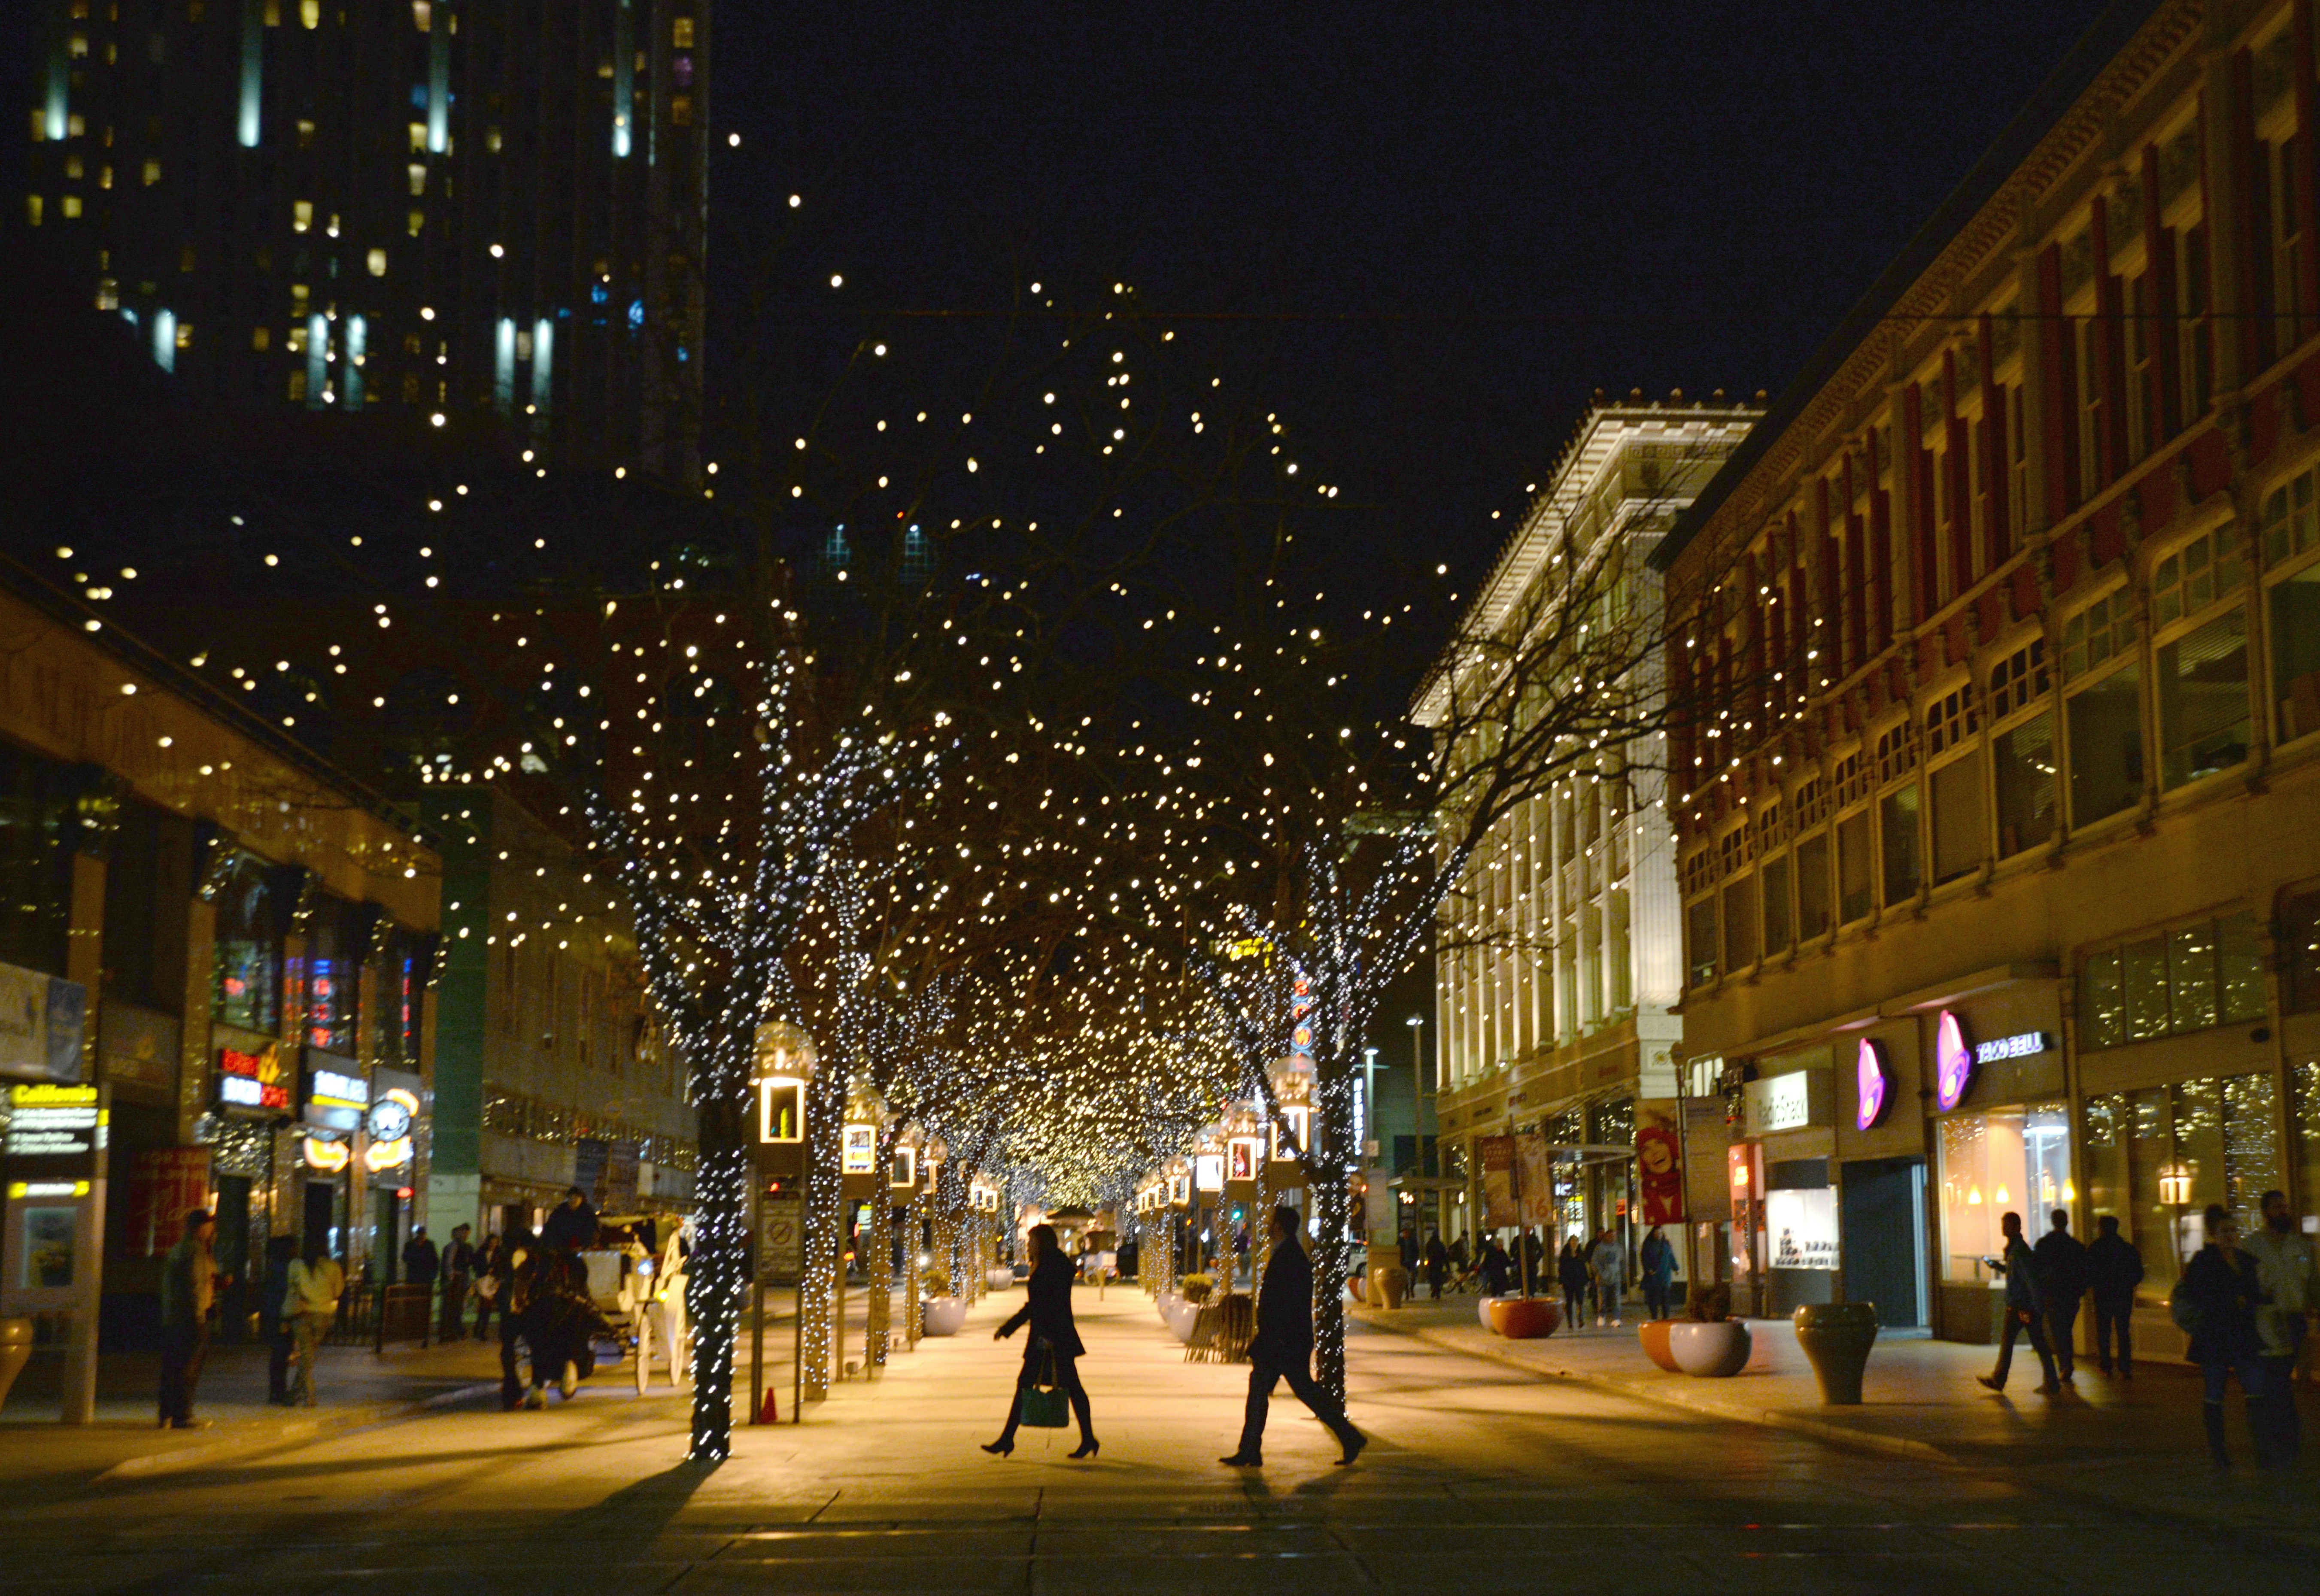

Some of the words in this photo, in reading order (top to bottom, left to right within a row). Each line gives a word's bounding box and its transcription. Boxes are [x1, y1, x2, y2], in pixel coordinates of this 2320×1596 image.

[1976, 1038, 2009, 1064] TACO
[2008, 1032, 2044, 1058] BELL
[11, 1084, 98, 1104] California
